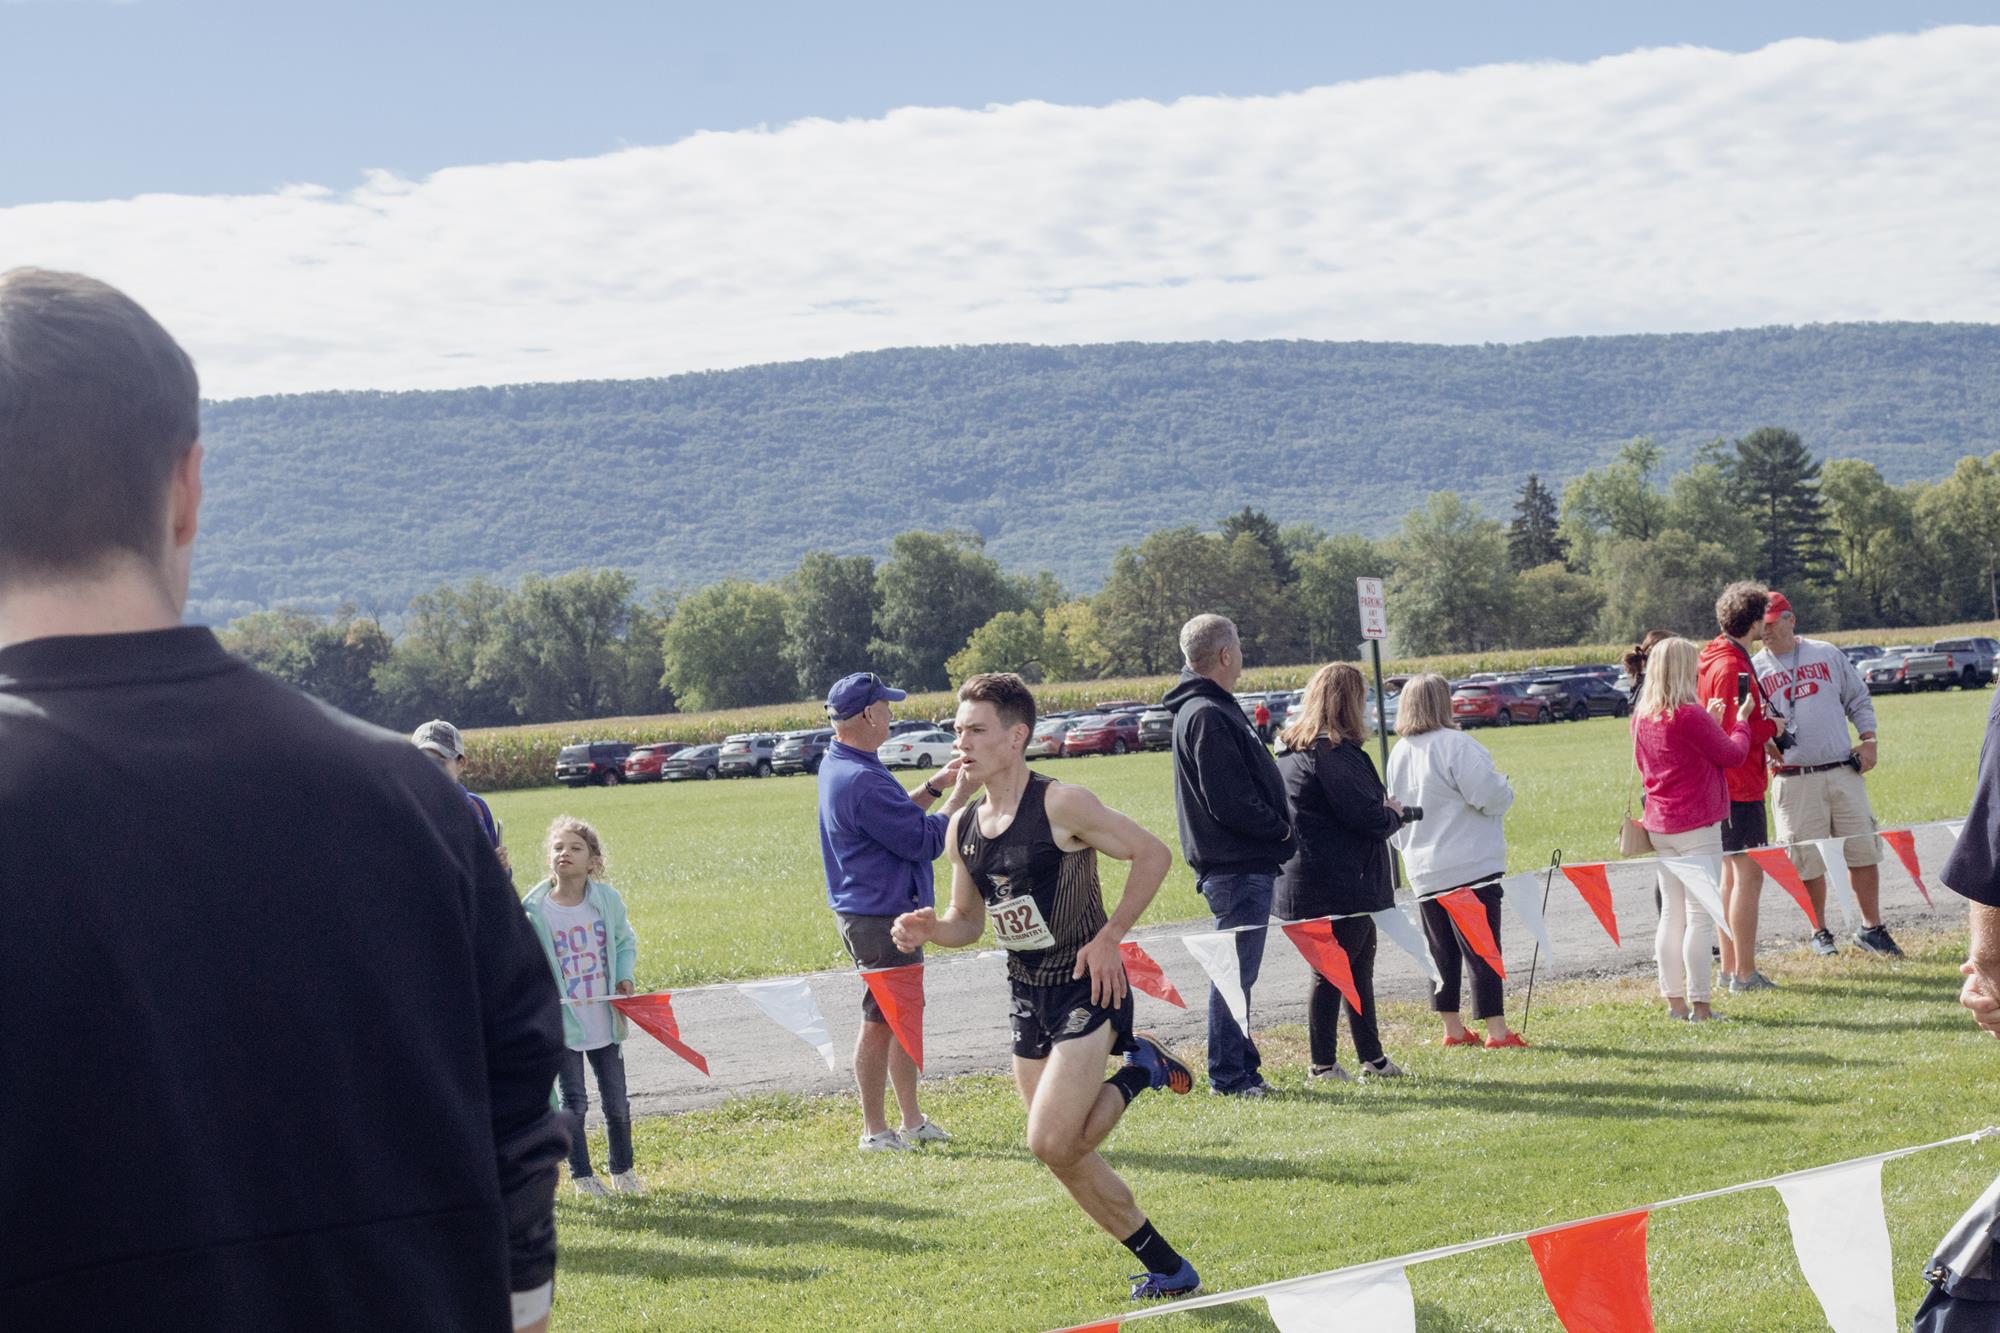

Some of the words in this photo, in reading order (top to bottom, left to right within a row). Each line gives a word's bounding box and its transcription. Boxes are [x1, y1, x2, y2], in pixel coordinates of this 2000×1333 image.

[1365, 582, 1377, 596] NO
[1360, 596, 1383, 609] PARKING
[1011, 927, 1043, 941] COUNTRY
